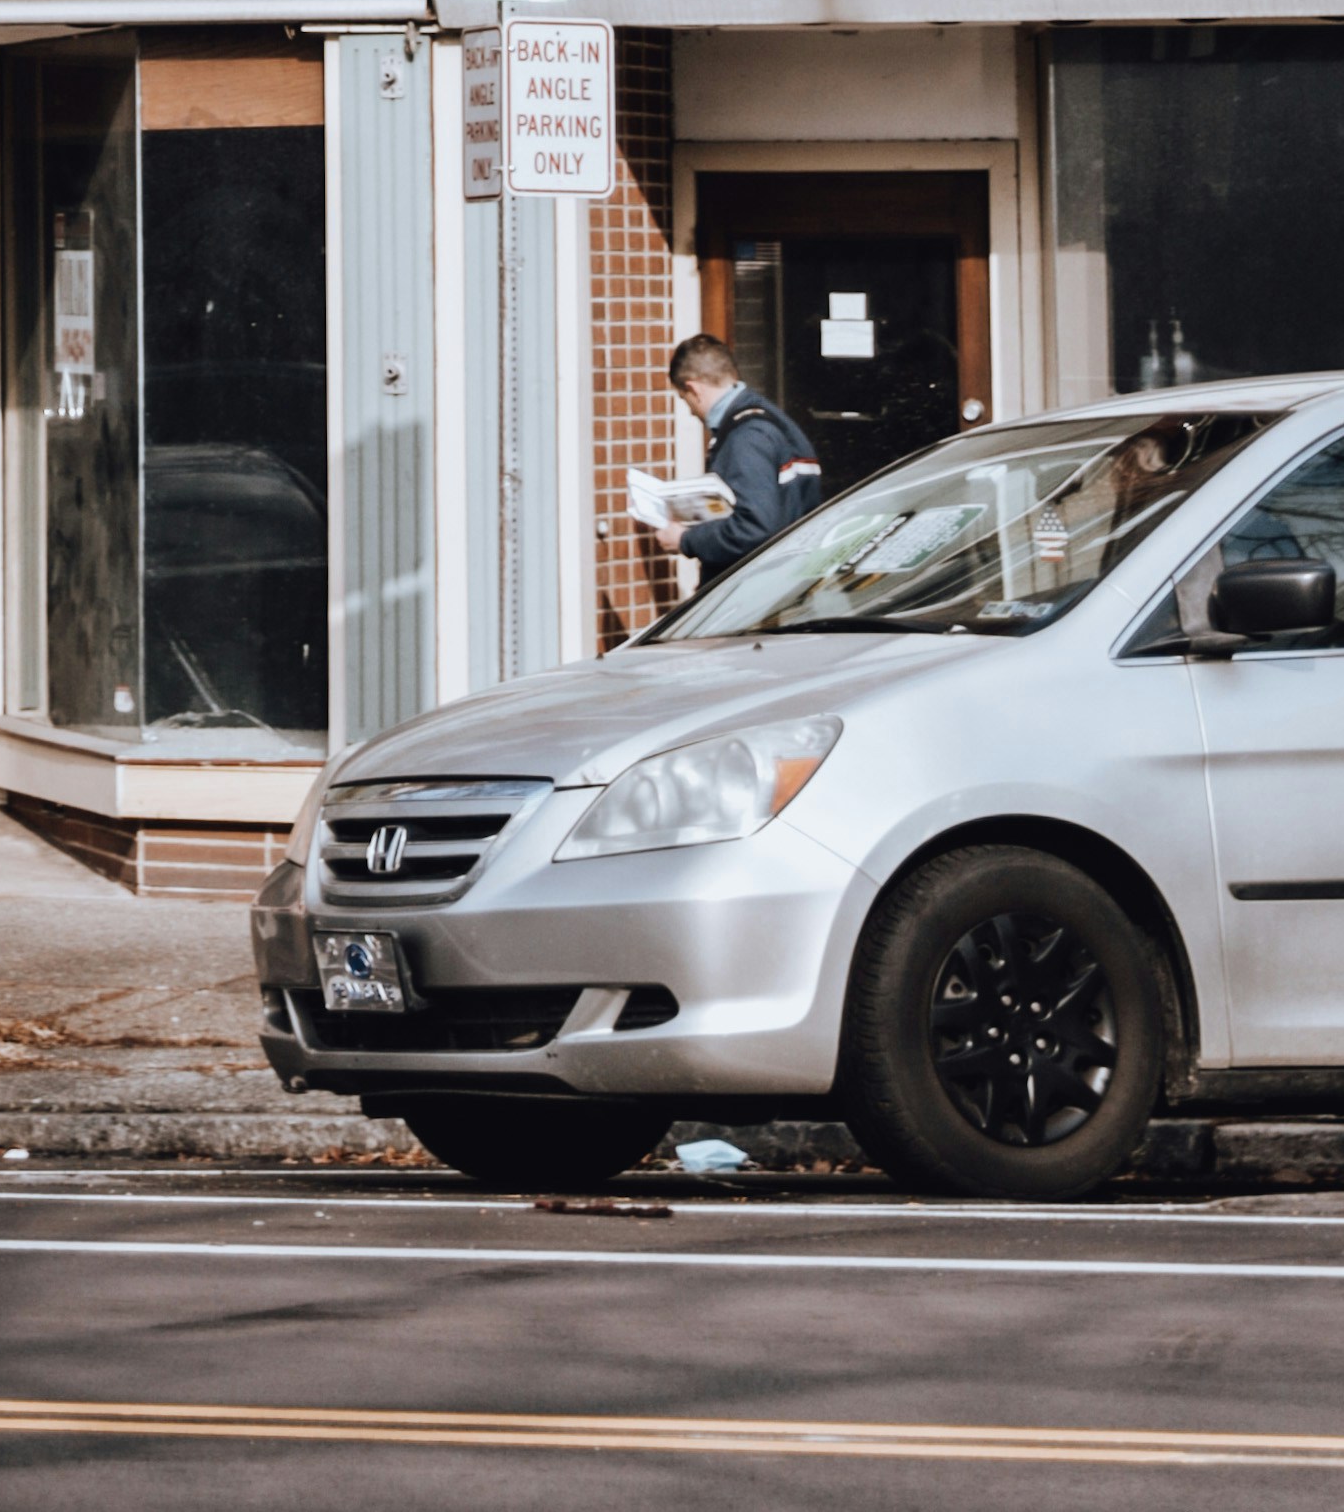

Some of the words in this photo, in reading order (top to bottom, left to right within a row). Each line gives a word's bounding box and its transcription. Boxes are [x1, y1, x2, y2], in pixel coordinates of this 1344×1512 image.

[517, 39, 601, 64] BACK-IN
[526, 77, 593, 102] ANGLE
[516, 113, 603, 140] PARKING
[534, 151, 585, 176] ONLY
